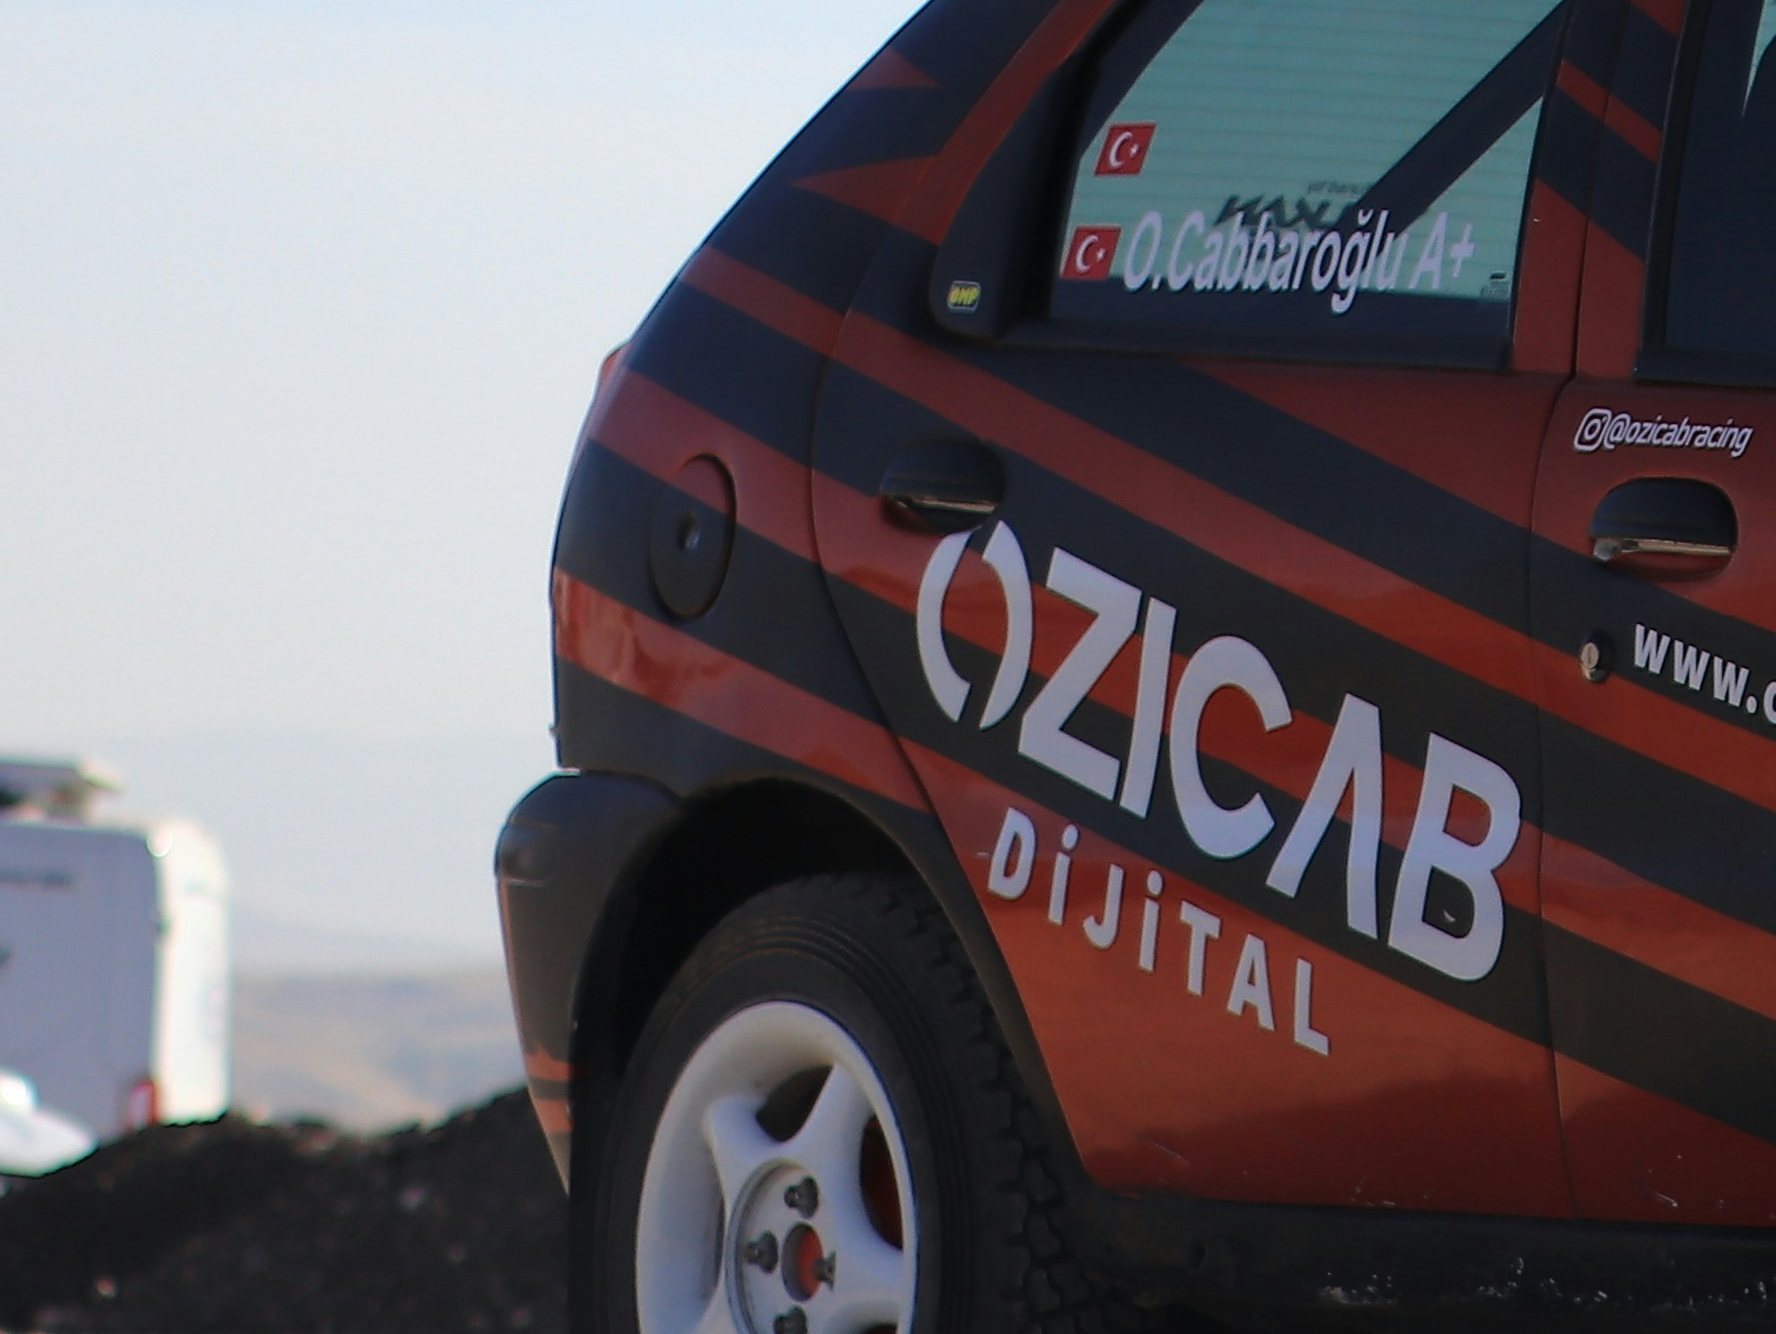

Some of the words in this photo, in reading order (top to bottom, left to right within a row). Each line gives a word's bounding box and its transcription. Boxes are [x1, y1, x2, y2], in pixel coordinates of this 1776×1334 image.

[1123, 208, 1407, 315] O.Cabbaroğlu
[1409, 211, 1475, 290] A+
[1602, 413, 1754, 458] @ozicabracing
[916, 520, 1523, 983] OZICAB
